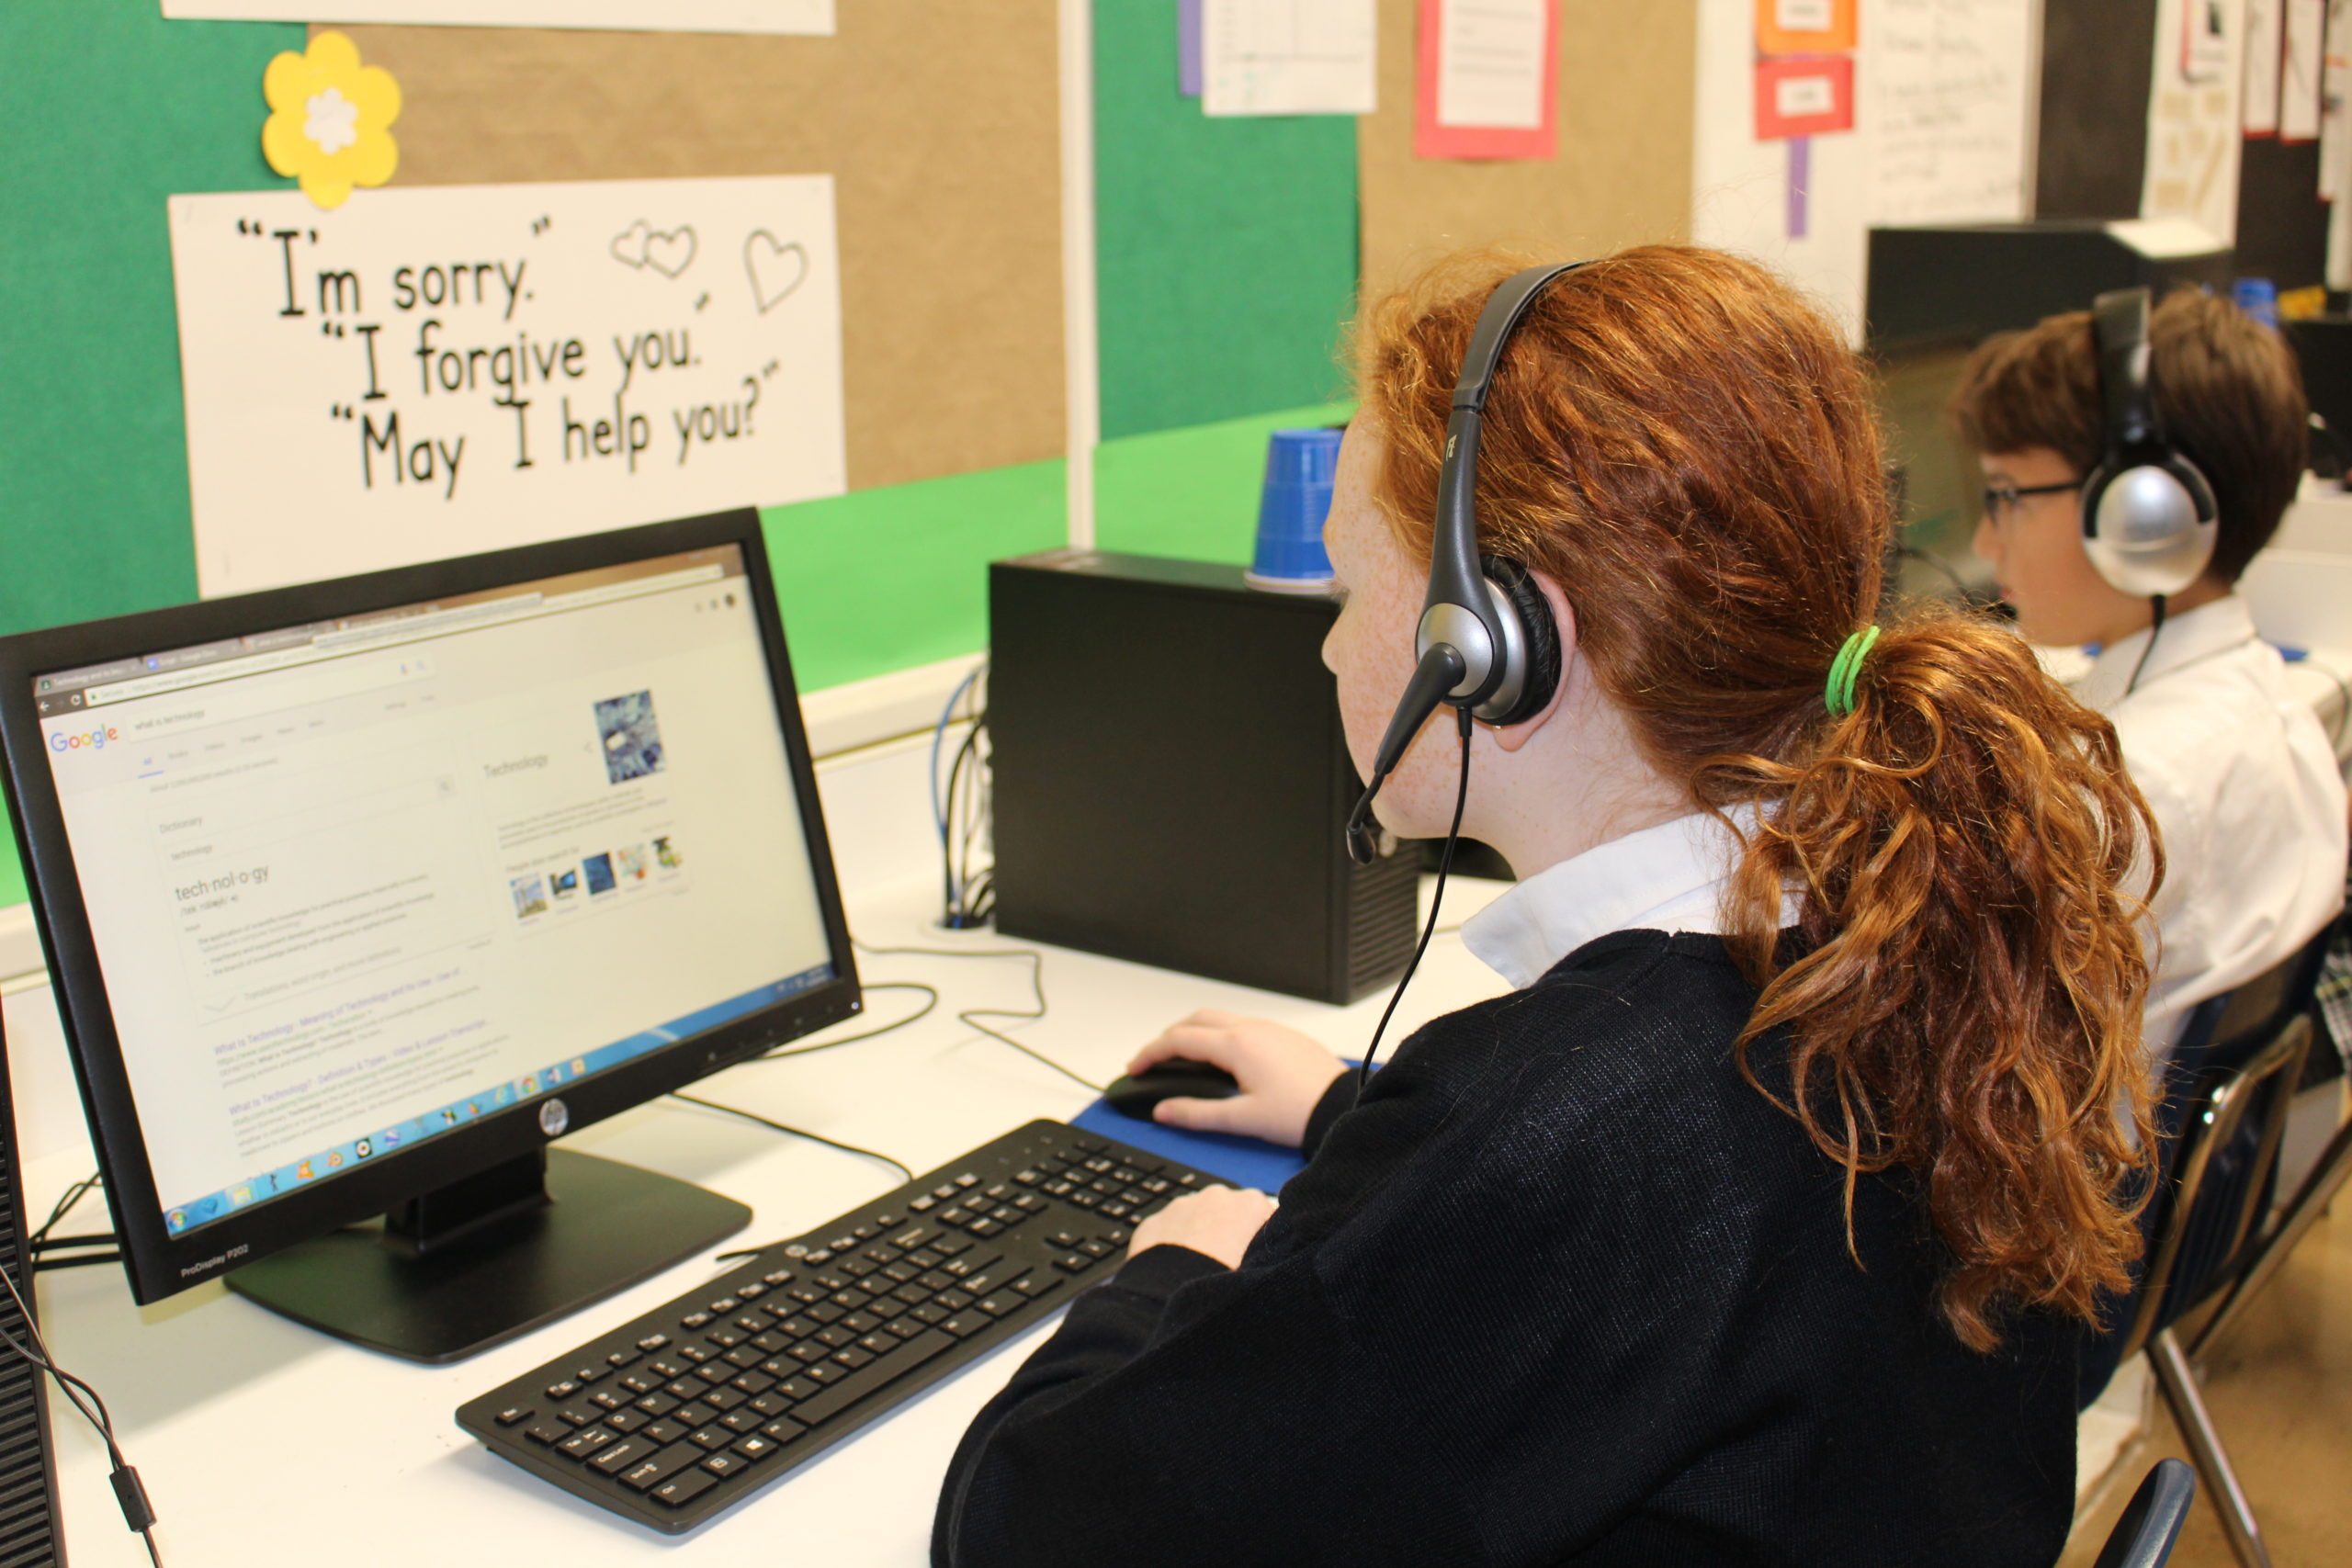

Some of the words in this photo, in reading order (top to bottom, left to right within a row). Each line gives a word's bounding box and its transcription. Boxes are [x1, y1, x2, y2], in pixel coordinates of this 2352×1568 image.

[413, 319, 587, 407] forgive
[511, 400, 535, 468] I
[561, 389, 650, 474] help
[51, 723, 119, 752] Google
[181, 1255, 226, 1278] ProDisplay
[227, 1243, 249, 1259] P202
